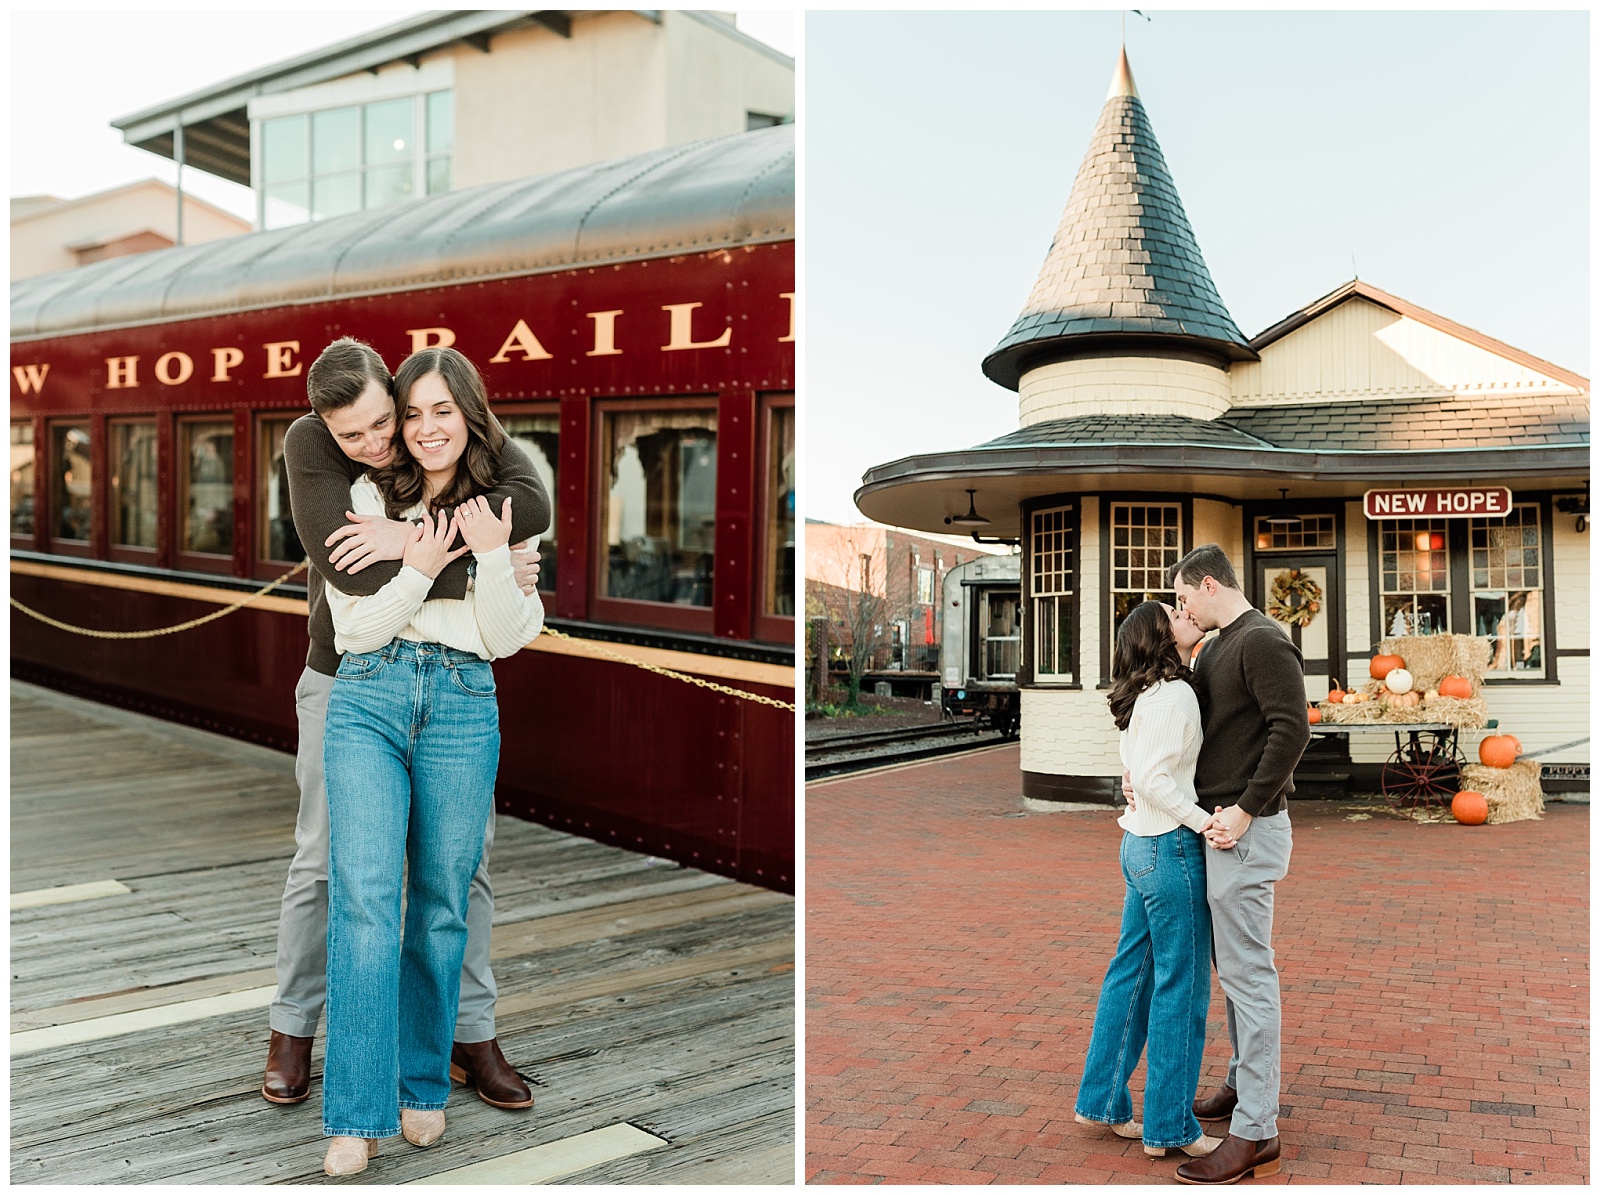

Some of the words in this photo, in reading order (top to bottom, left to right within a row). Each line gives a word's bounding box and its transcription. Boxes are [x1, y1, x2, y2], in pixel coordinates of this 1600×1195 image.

[104, 340, 302, 389] HOPE
[405, 292, 795, 364] RAIL
[1375, 494, 1427, 513] NEW
[1437, 491, 1501, 512] HOPE
